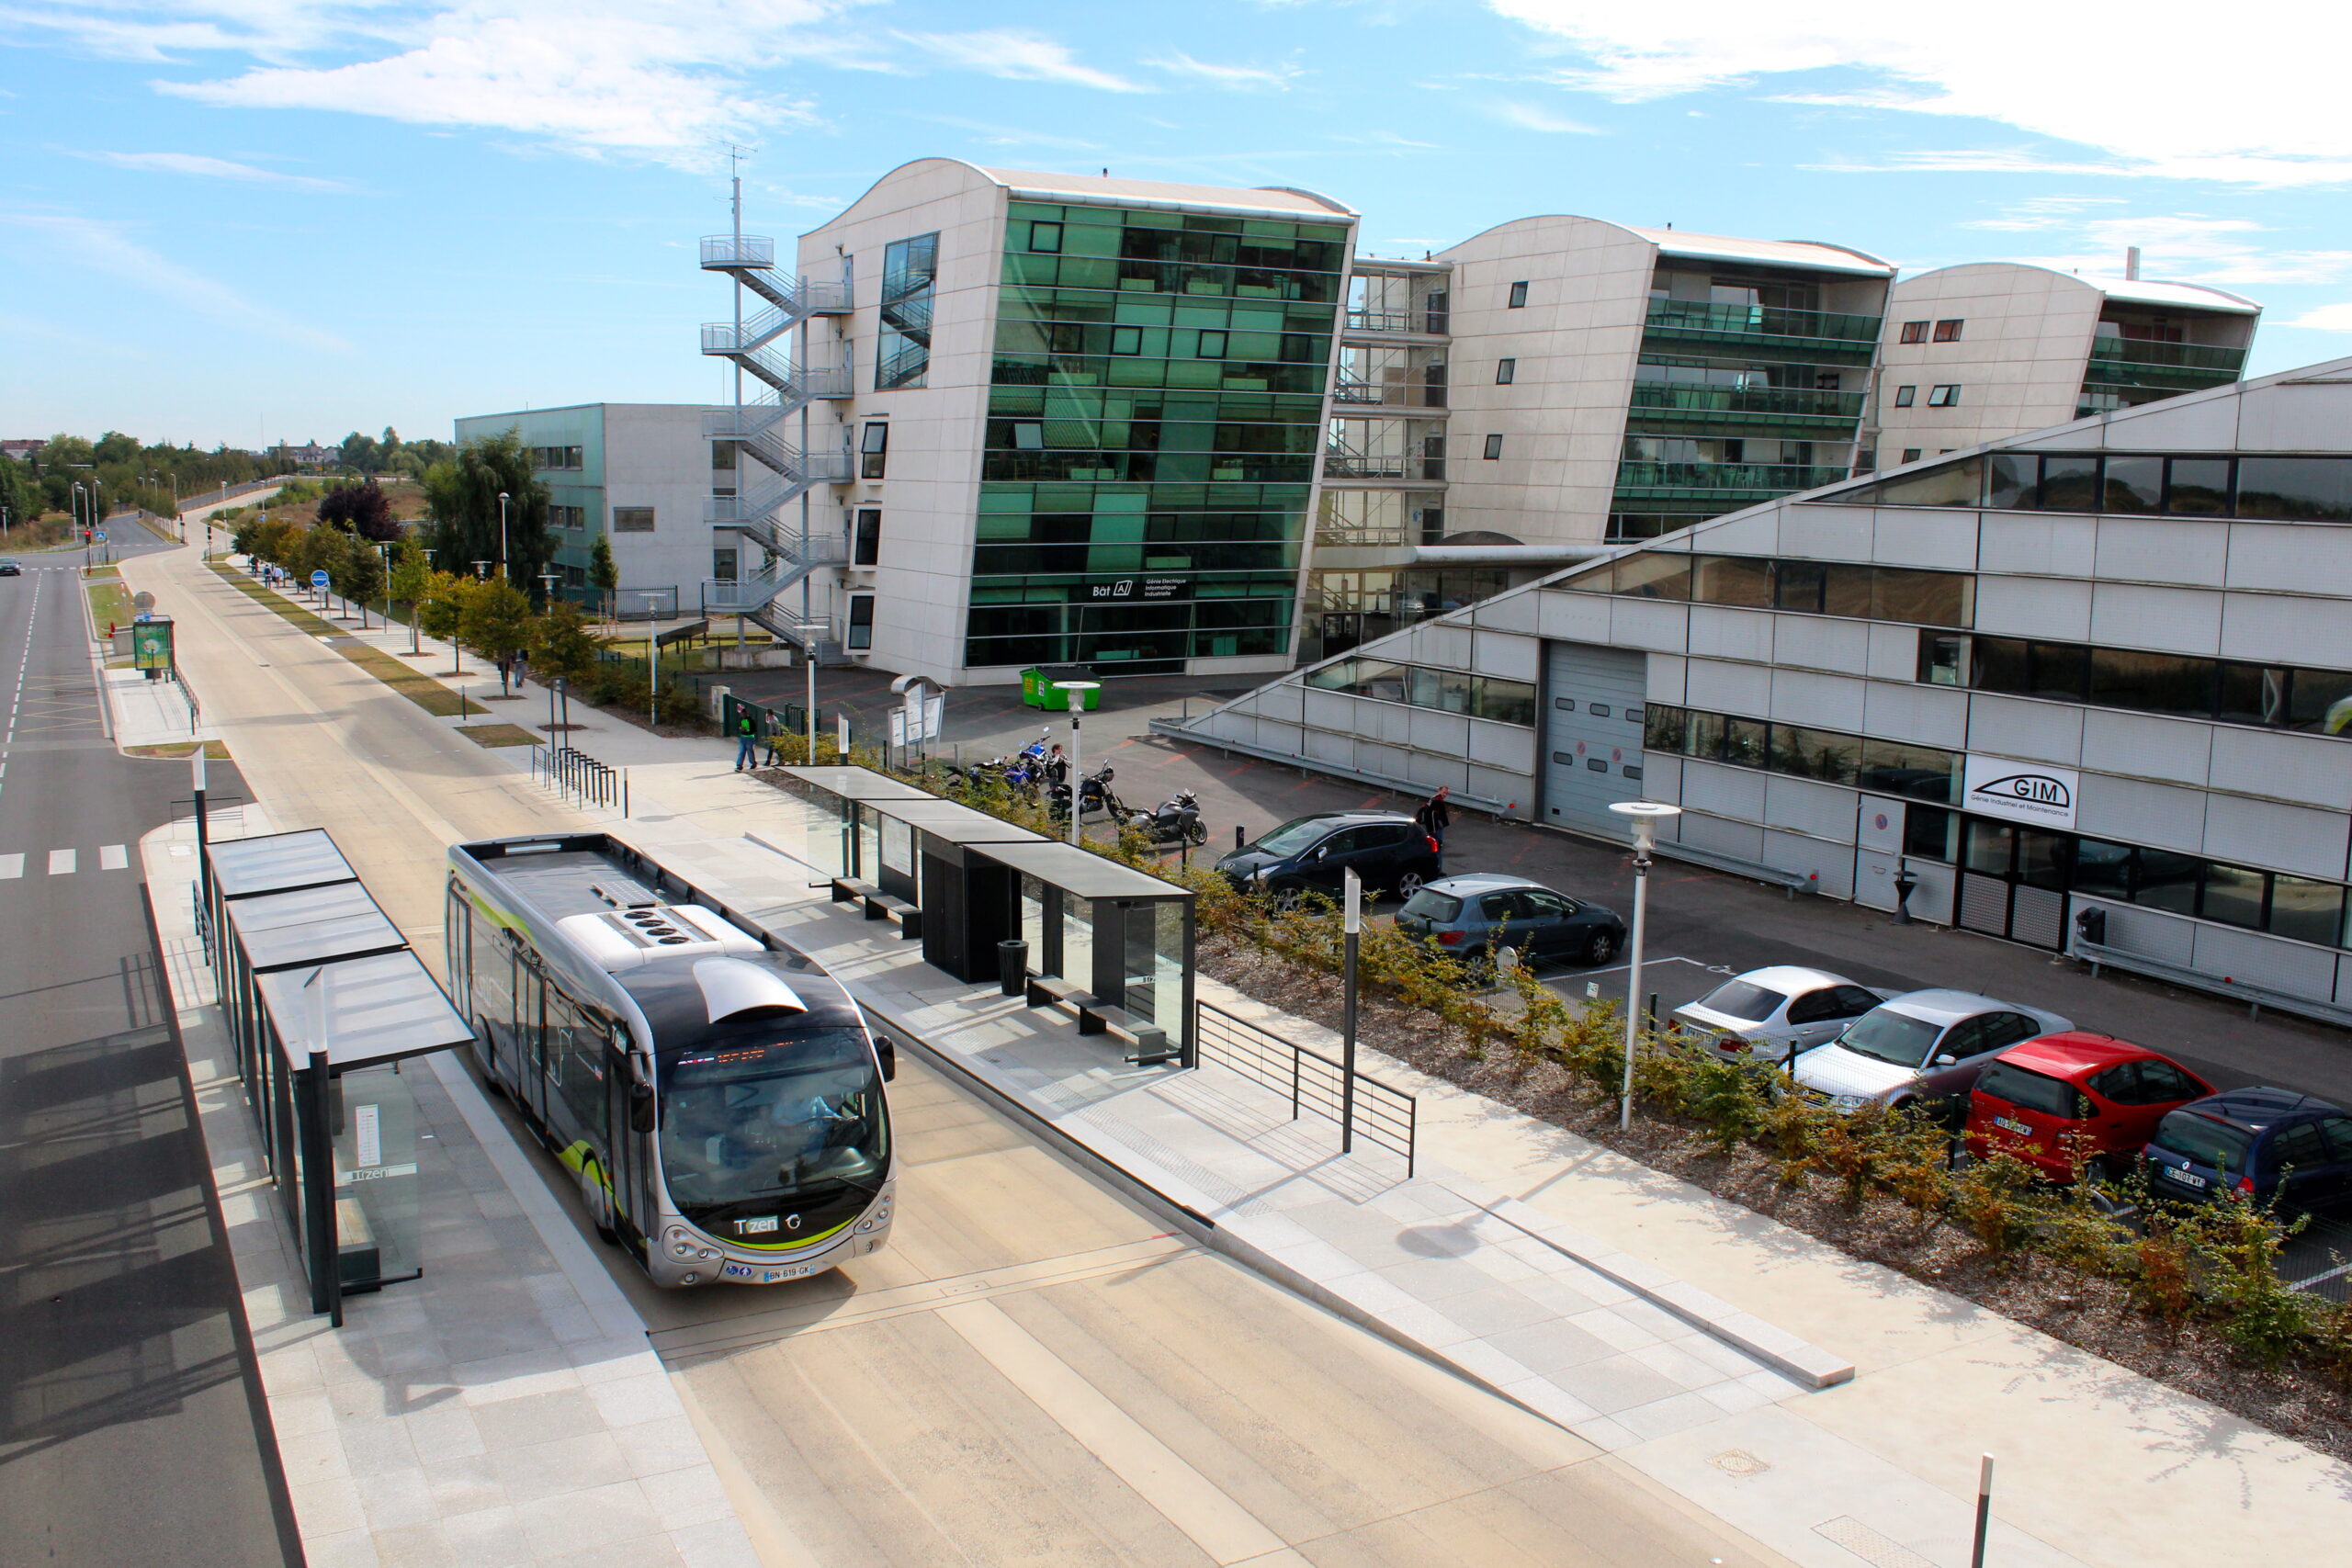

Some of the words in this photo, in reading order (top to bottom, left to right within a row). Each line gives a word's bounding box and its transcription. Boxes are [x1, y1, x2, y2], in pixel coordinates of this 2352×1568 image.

[1092, 586, 1110, 596] Bât
[2014, 778, 2057, 802] GIM
[1970, 795, 1989, 803] Génie
[1990, 797, 2018, 807] Industriel
[2026, 804, 2069, 818] Maintenance
